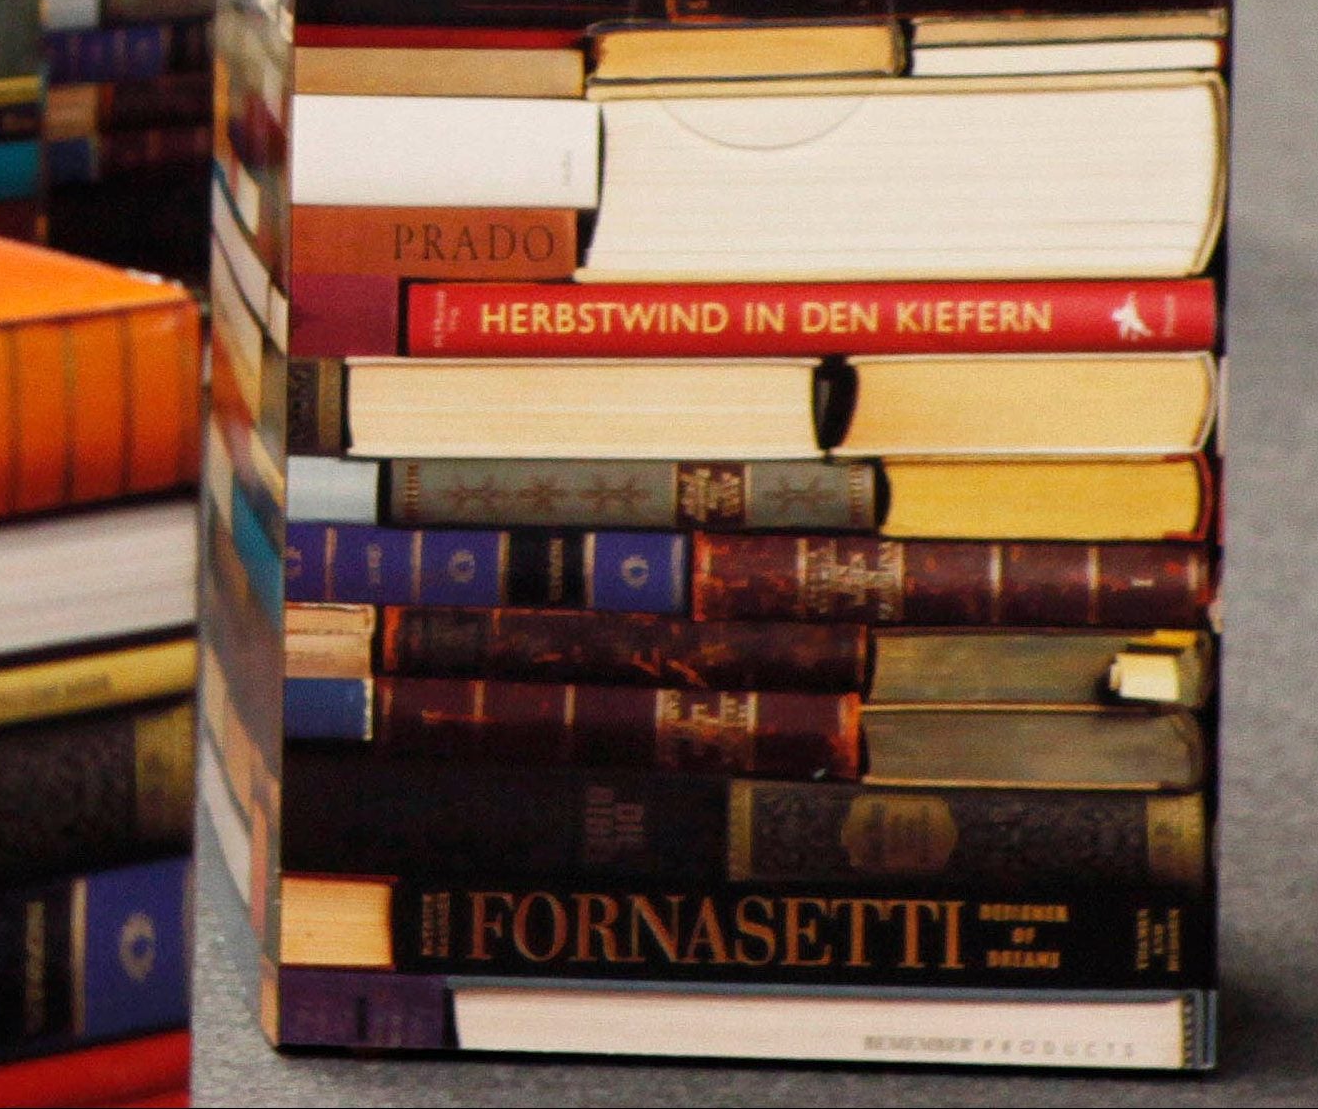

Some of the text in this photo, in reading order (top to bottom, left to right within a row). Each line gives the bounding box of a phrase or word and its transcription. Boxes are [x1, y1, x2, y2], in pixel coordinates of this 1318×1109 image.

[392, 222, 555, 263] PRADO
[479, 301, 730, 336] HERBSTWIND
[743, 301, 786, 335] IN
[800, 301, 879, 335] DEN
[894, 300, 1053, 335] KIEFERN
[466, 890, 966, 970] FORNASETTI
